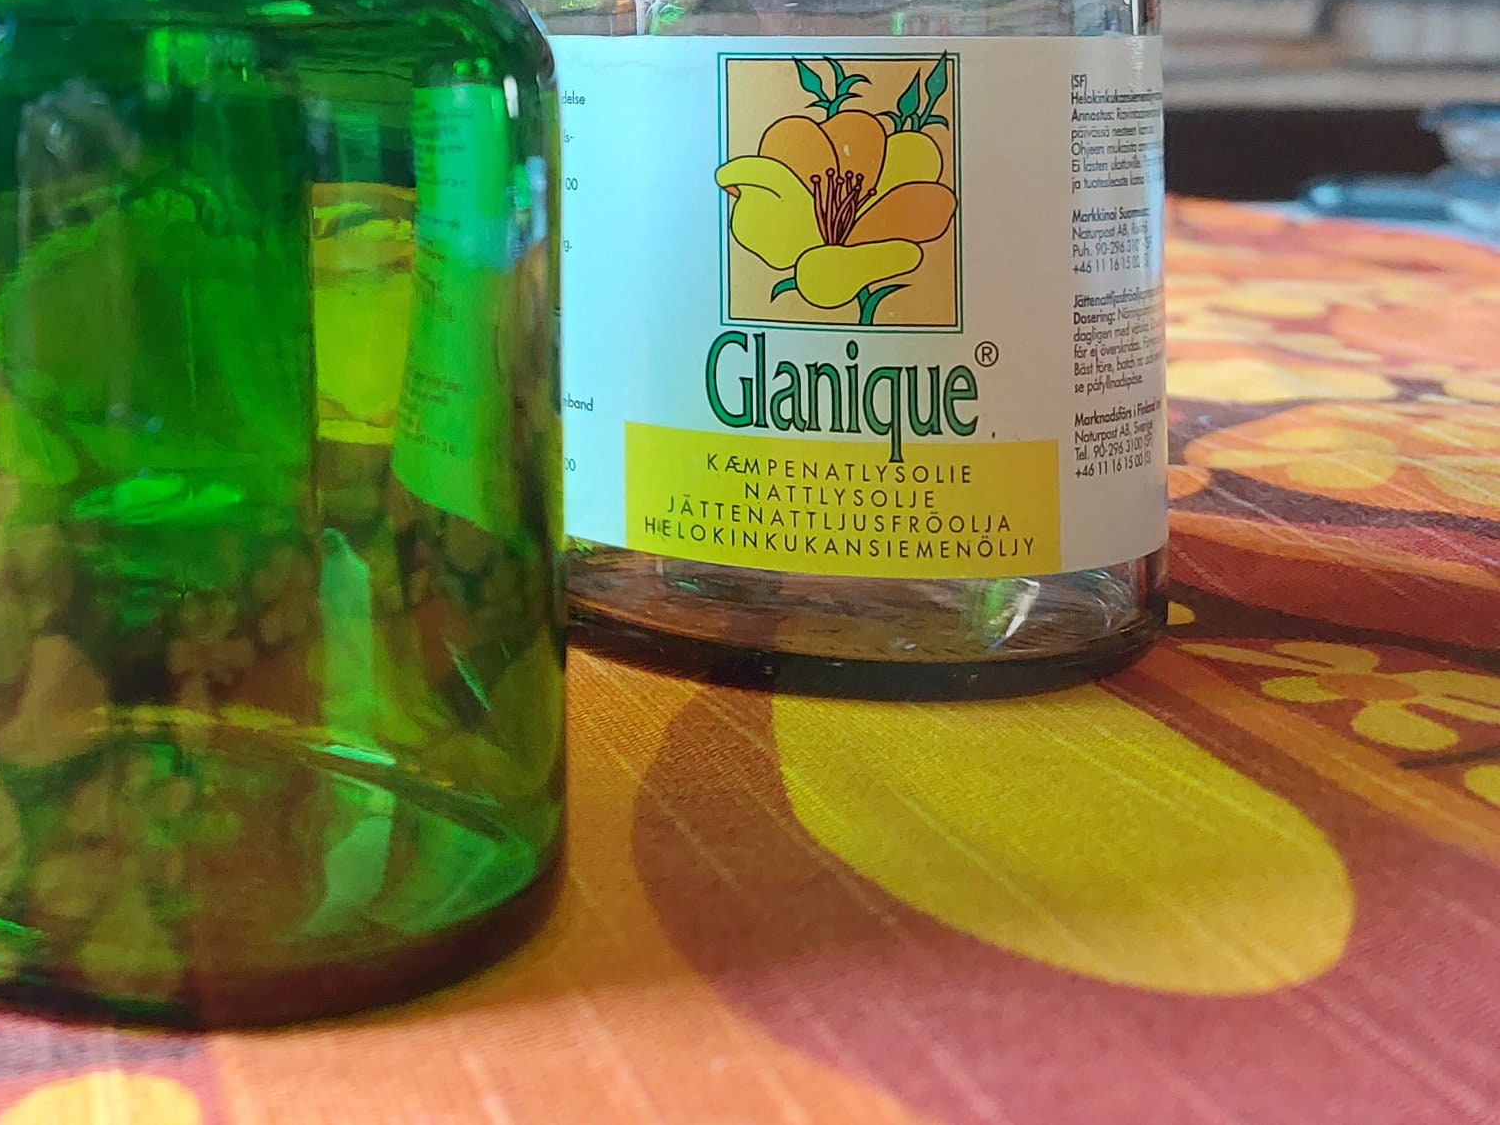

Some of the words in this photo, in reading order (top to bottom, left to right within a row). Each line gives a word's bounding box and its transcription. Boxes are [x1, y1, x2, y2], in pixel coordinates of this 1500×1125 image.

[706, 452, 973, 484] KÆMPENATLYSOLIE
[1075, 463, 1095, 478] +46
[744, 481, 935, 510] NATTLYSOLJE
[667, 493, 1011, 533] JÄTTENATTLJUSFRÖOLJA
[644, 515, 1035, 558] HELOKINKUKANSIEMENÖLJY
